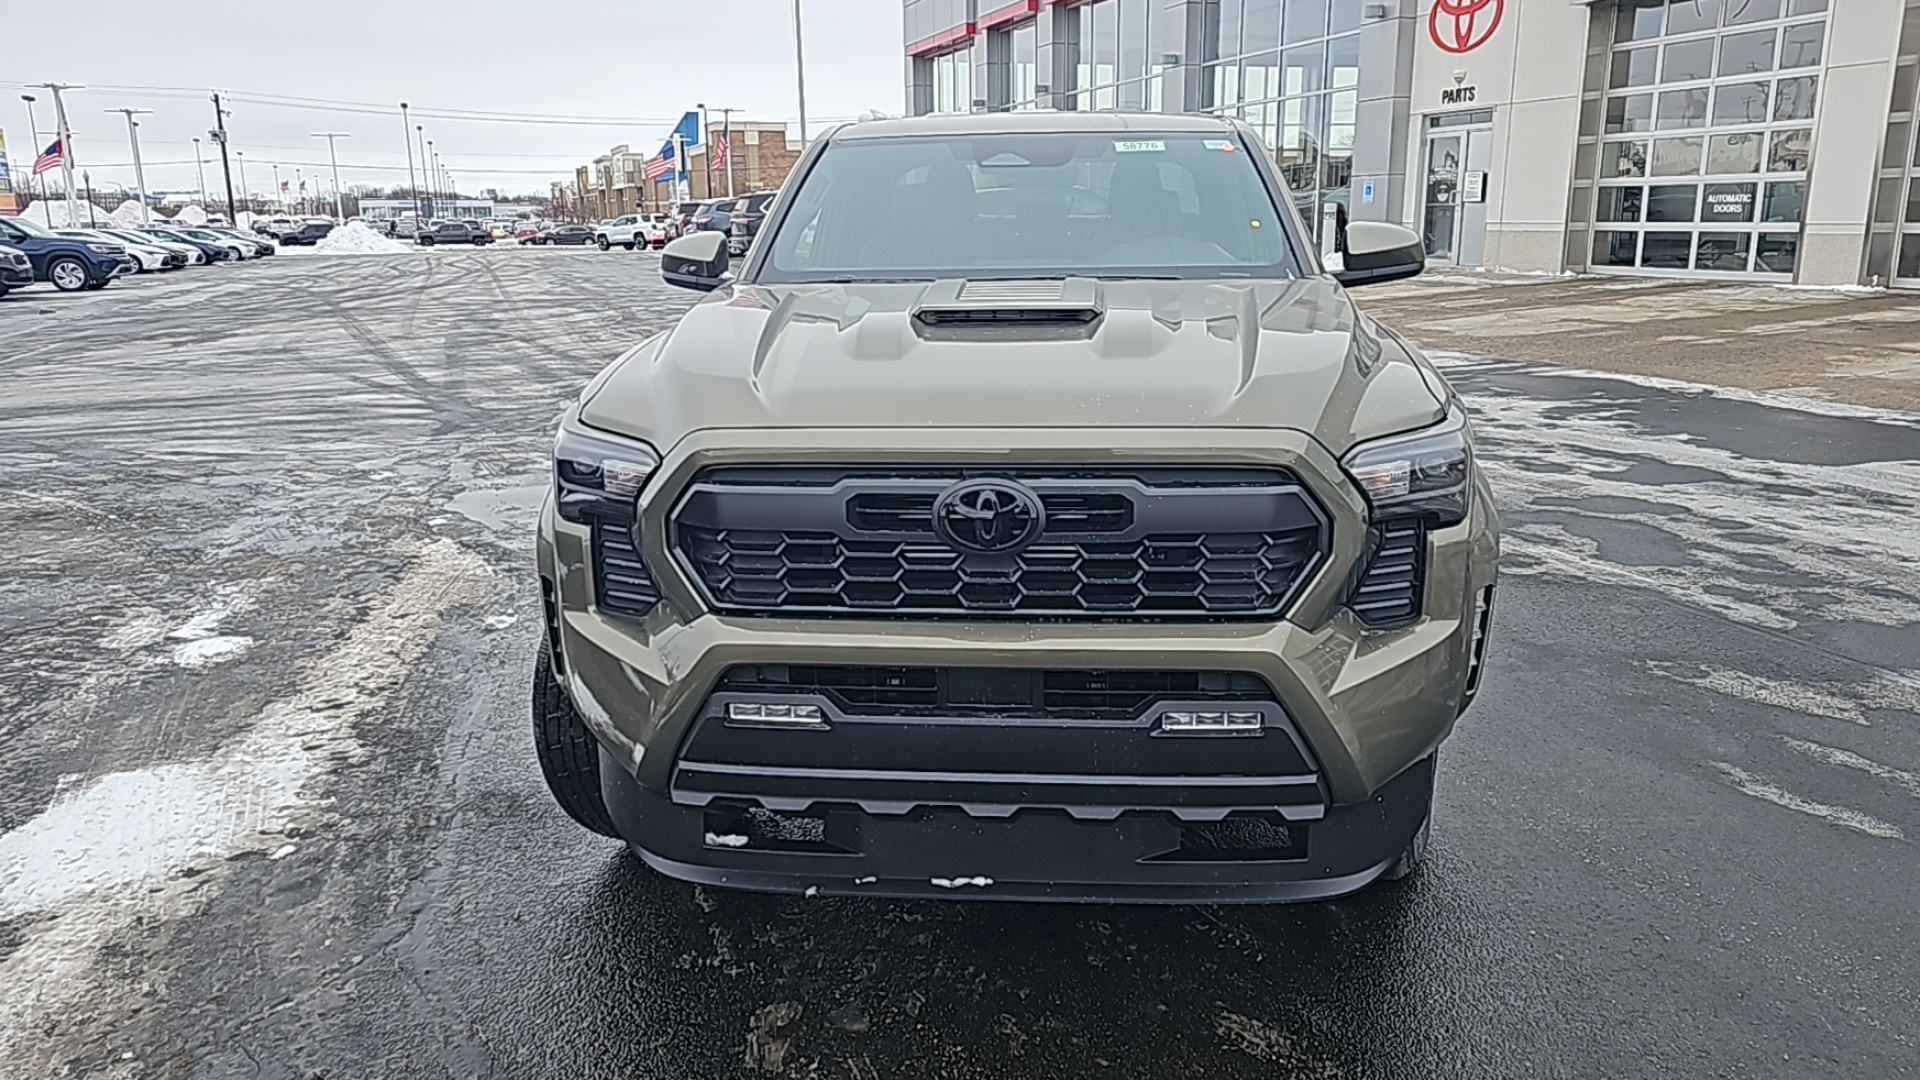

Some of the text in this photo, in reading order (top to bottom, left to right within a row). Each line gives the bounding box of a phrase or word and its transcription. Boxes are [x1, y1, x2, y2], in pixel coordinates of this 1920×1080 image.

[1442, 86, 1476, 104] PARTS
[1123, 142, 1158, 150] 58776
[1707, 194, 1752, 203] AUTOMATIC
[1713, 204, 1743, 213] DOORS
